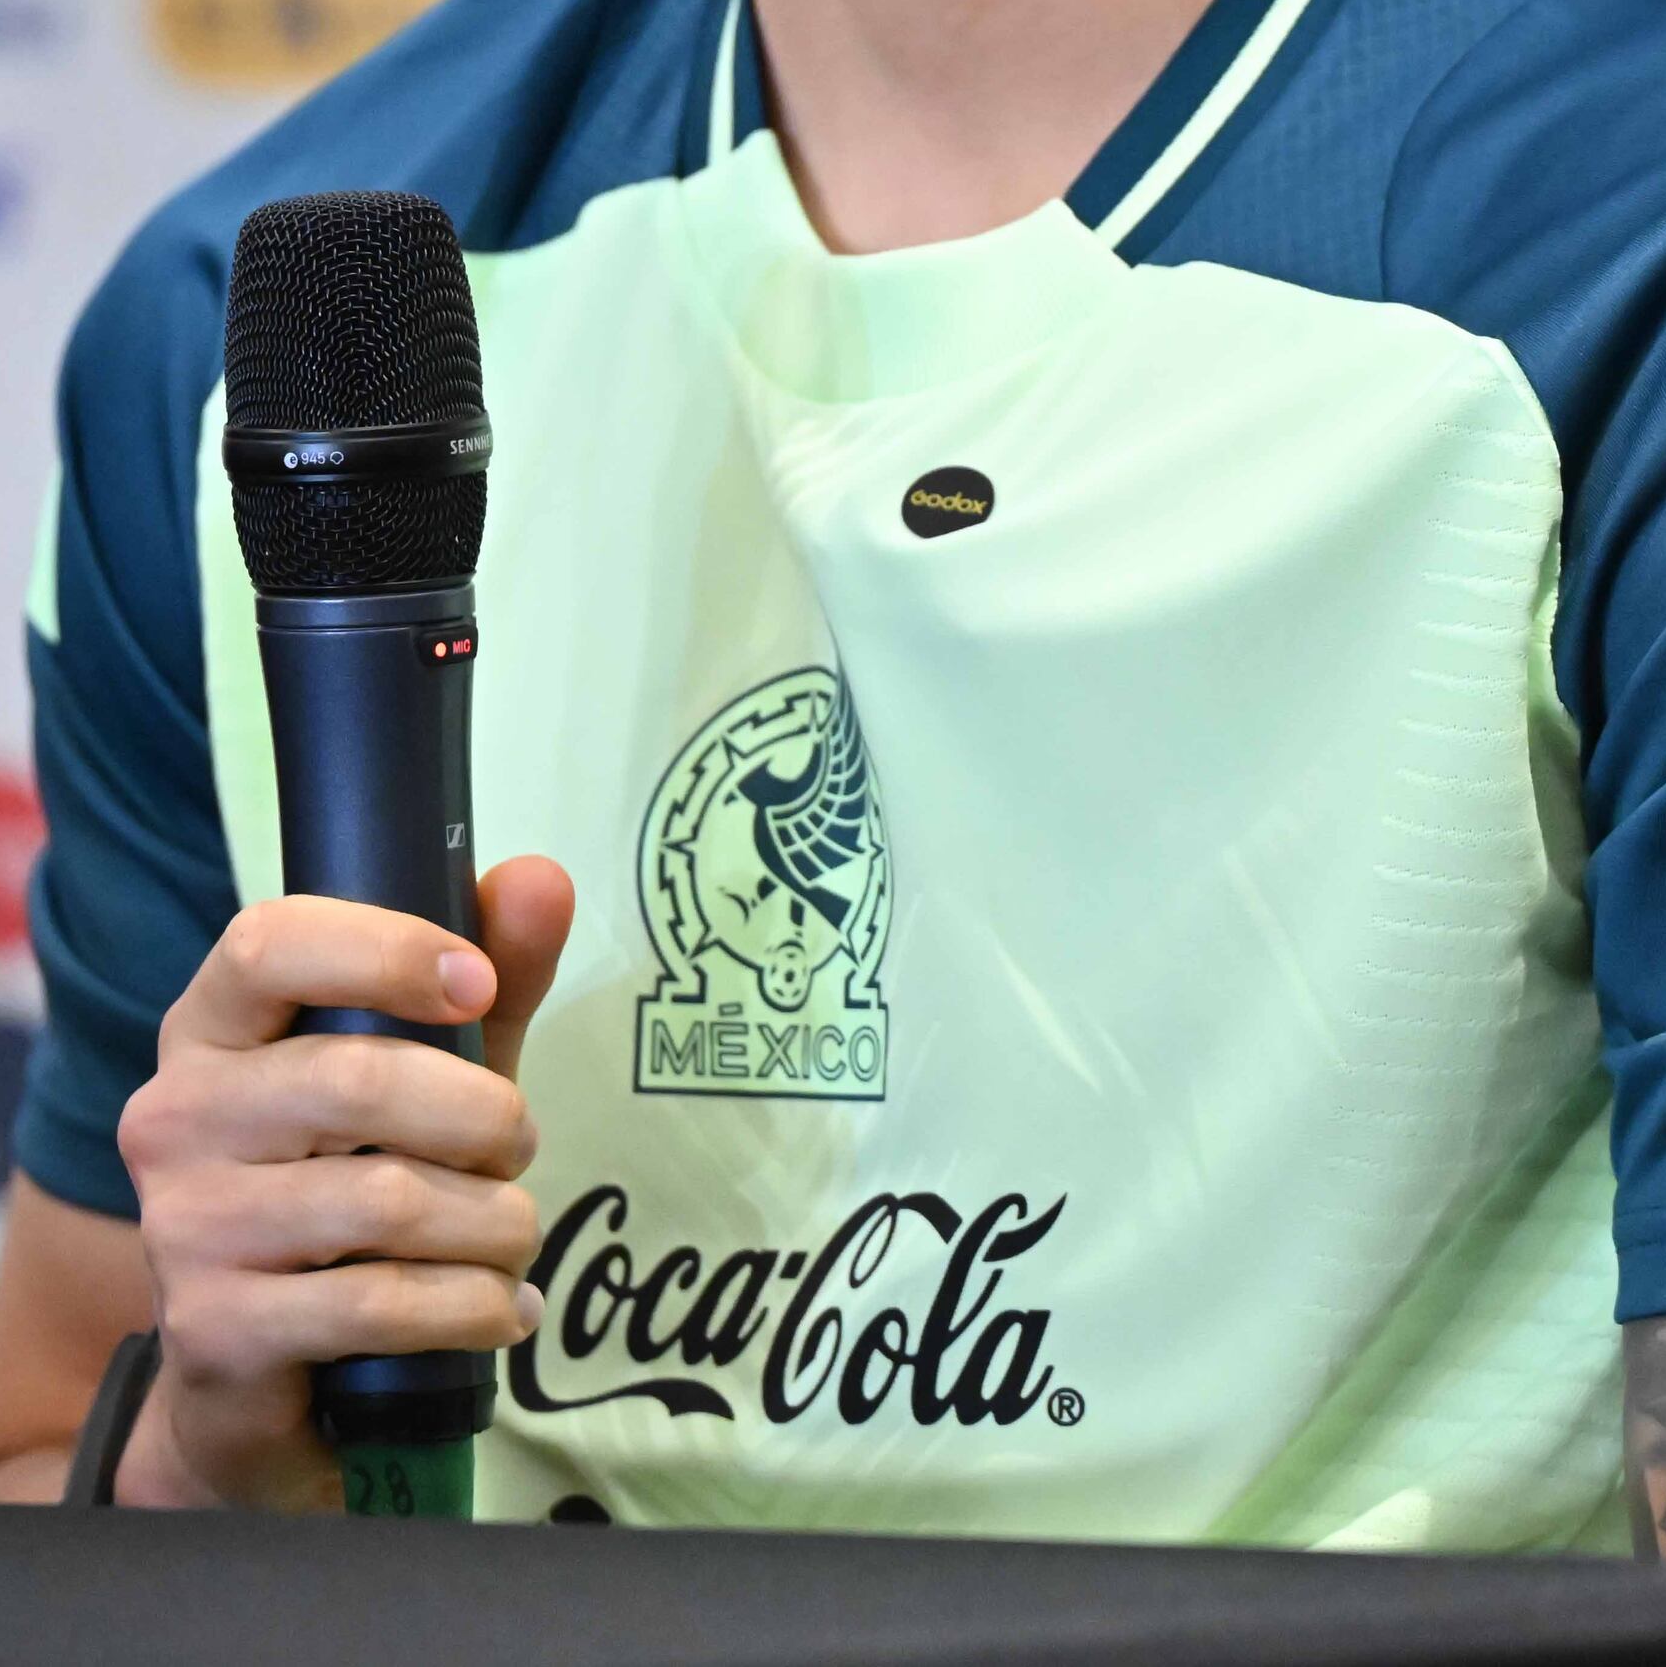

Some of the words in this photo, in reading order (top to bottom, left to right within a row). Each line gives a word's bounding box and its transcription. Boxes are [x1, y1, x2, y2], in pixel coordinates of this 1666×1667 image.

[301, 452, 326, 465] 945
[453, 638, 471, 654] MIC
[650, 1002, 881, 1082] MÉXICO
[507, 1183, 1069, 1427] Coca-Cola
